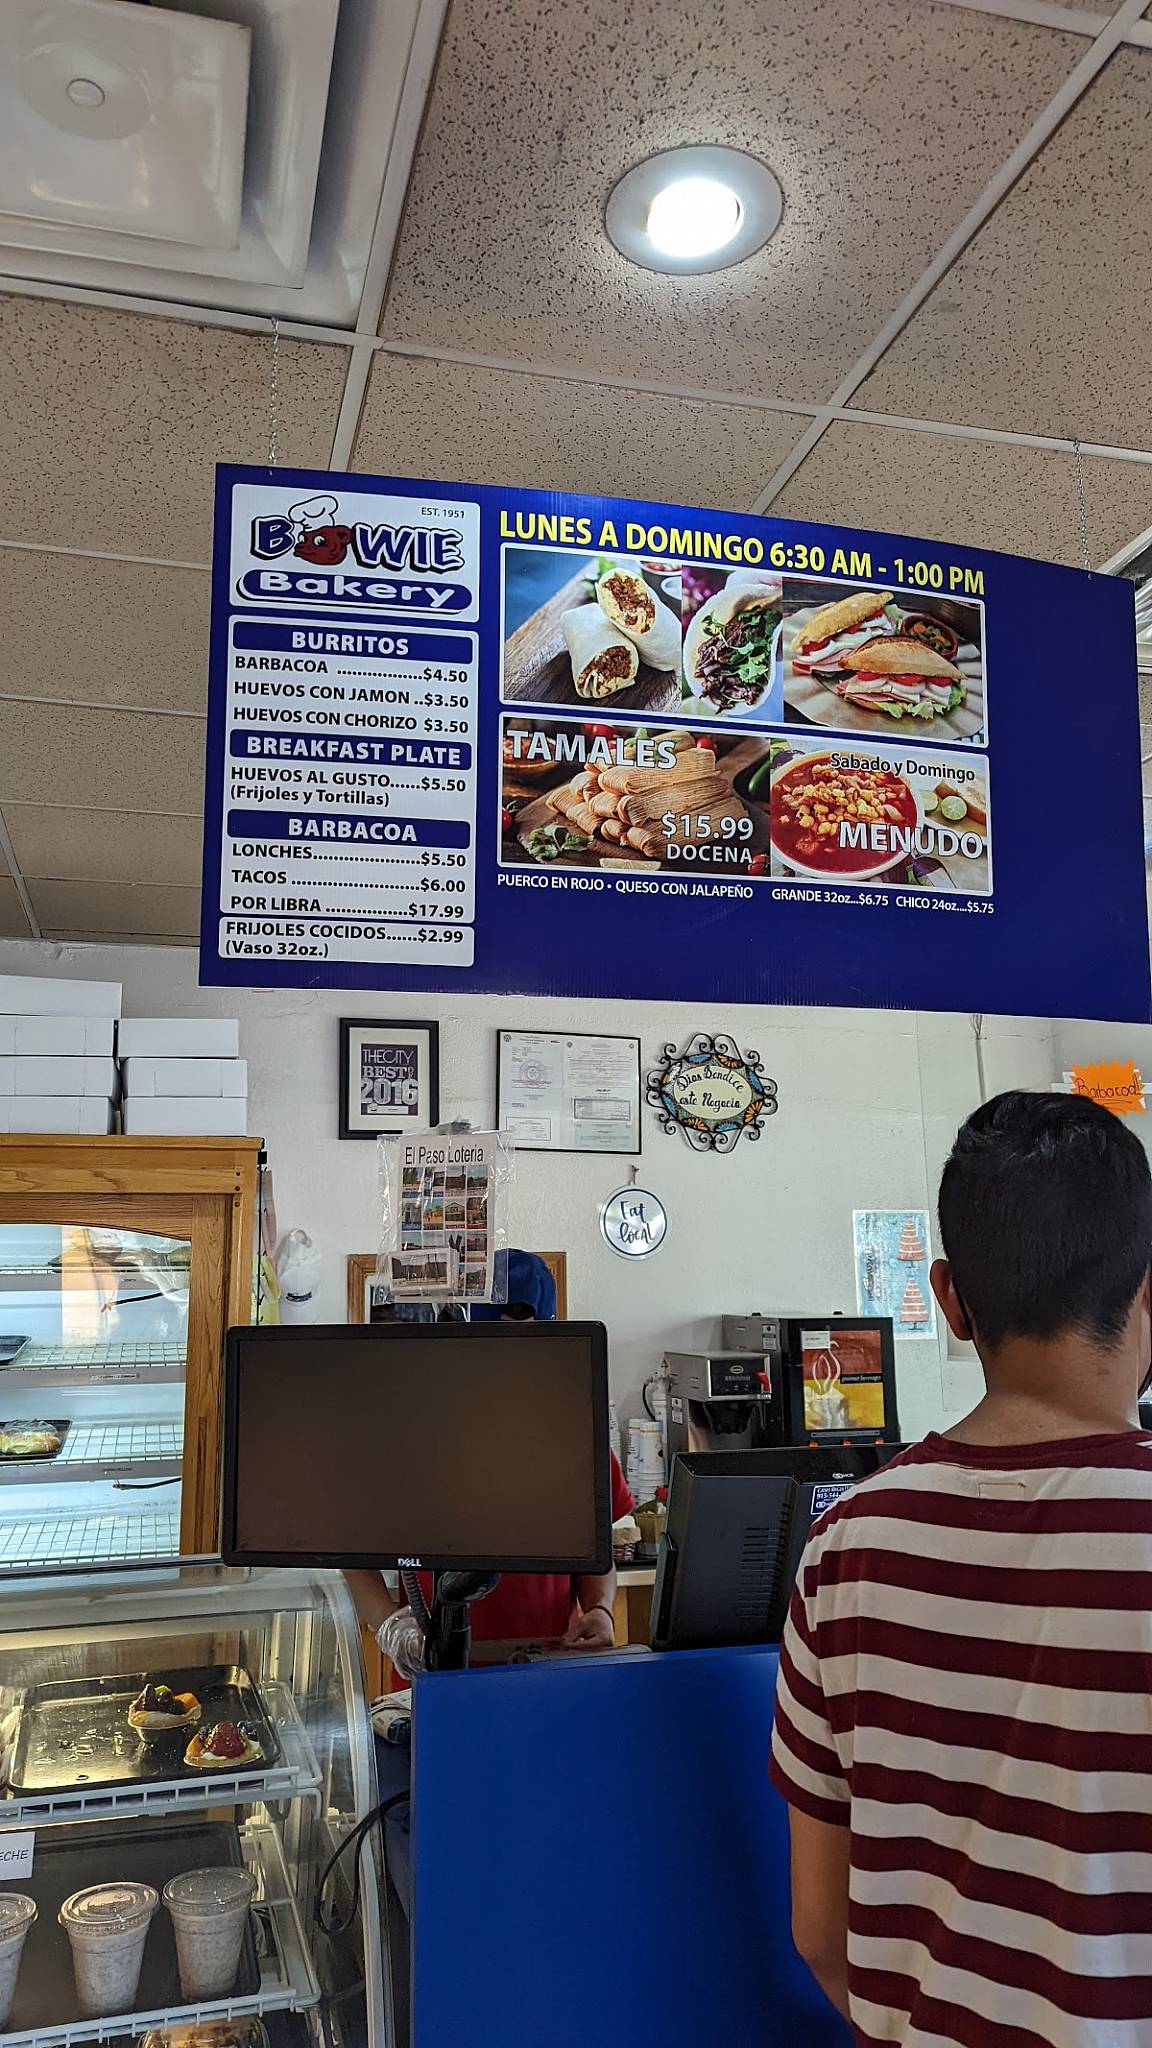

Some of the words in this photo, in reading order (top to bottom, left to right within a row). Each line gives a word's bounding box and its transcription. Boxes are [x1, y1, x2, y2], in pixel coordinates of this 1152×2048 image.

[422, 507, 440, 516] EST.
[443, 509, 465, 520] 1951
[250, 516, 465, 574] BWIE
[500, 510, 592, 545] LUNES
[598, 520, 618, 548] A
[626, 522, 764, 564] DOMINGO
[770, 542, 825, 572] 6:30
[830, 548, 872, 578] AM
[894, 558, 944, 589] 1:00
[950, 566, 984, 596] PM
[259, 571, 455, 608] Bakery
[292, 631, 409, 655] BURRITOS
[235, 656, 328, 674] BARBACOA
[234, 682, 304, 698] HUEVOS
[310, 686, 346, 700] CON
[349, 688, 410, 704] JAMON
[233, 706, 302, 724] HUEVOS
[306, 710, 341, 726] CON
[344, 713, 417, 730] CHORIZO
[424, 717, 468, 734] $3.50
[247, 736, 384, 760] BREAKFAST
[391, 744, 461, 766] PLATE
[506, 729, 678, 770] TAMALES
[231, 766, 302, 783] HUEVOS
[306, 770, 328, 784] AL
[831, 752, 891, 774] Sabado
[894, 761, 903, 776] y
[906, 759, 976, 784] Domingo
[230, 784, 299, 803] (Frijoles
[303, 791, 313, 804] y
[316, 789, 390, 808] Tortillas)
[288, 818, 417, 842] BARBACOA
[660, 810, 754, 841] $15.99
[839, 820, 984, 861] MENUDO
[666, 843, 753, 865] DOCENA
[232, 870, 287, 885] TACOS
[497, 874, 549, 888] PUERCO
[552, 876, 569, 890] EN
[571, 877, 604, 891] ROJO
[615, 880, 659, 895] QUESO
[661, 882, 688, 896] CON
[690, 883, 754, 900] JALAPEÑO
[231, 896, 267, 910] POR
[271, 898, 322, 913] LIBRA
[772, 888, 822, 902] GRANDE
[896, 896, 930, 909] CHICO
[226, 921, 305, 938] FRIJOLES
[225, 940, 273, 956] (Vaso
[276, 942, 329, 958] 32oz.)
[362, 1065, 407, 1078] BEST
[677, 1072, 702, 1092] Dios
[704, 1064, 744, 1094] Bendice
[361, 1078, 418, 1106] 2016
[702, 1092, 742, 1112] Negocio
[405, 1147, 416, 1164] El
[419, 1146, 444, 1164] Paso
[398, 1558, 422, 1567] DELL
